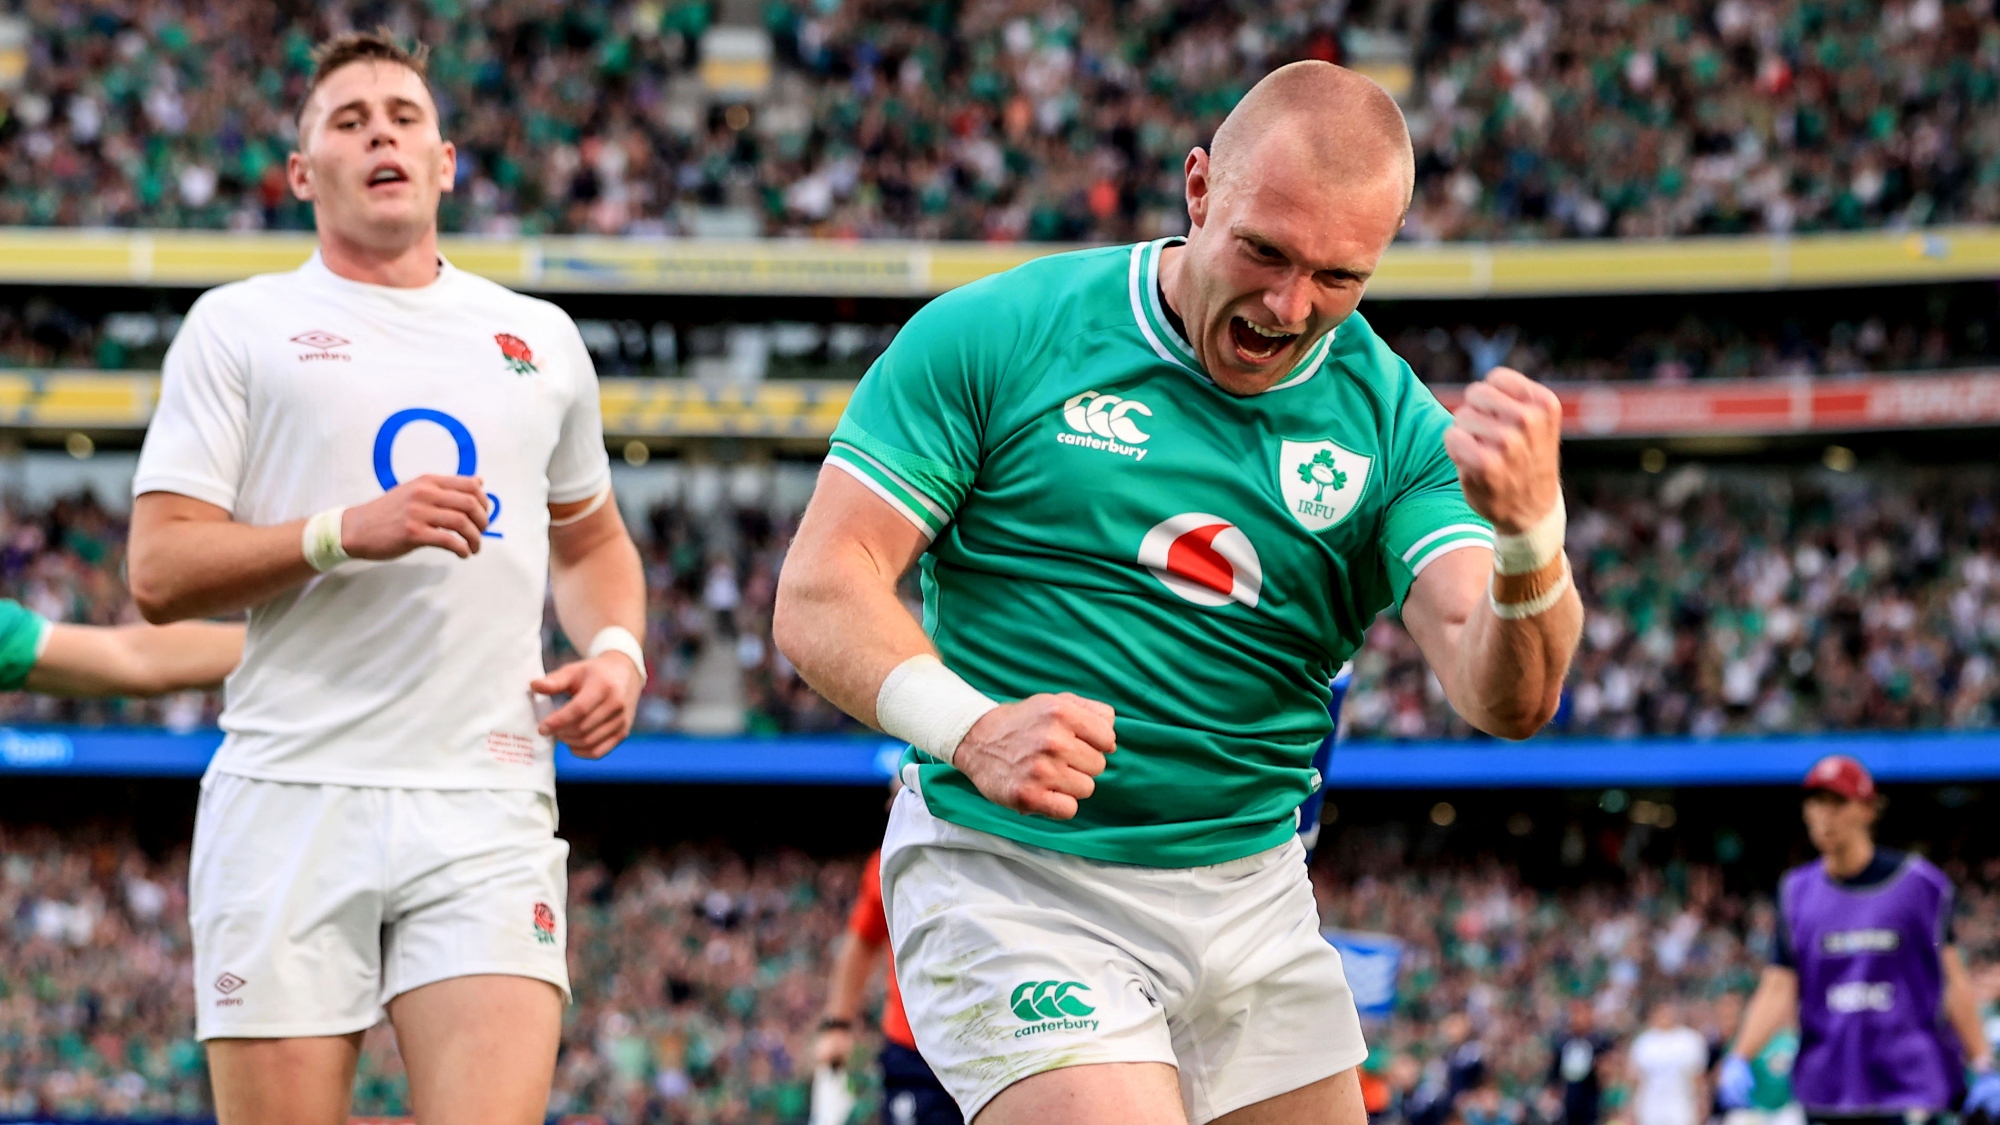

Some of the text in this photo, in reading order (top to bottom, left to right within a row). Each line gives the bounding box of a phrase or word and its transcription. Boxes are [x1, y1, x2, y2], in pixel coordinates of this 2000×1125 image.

[1056, 432, 1148, 462] canterbury
[1297, 499, 1336, 520] IRFU
[1014, 1018, 1099, 1038] canterbury
